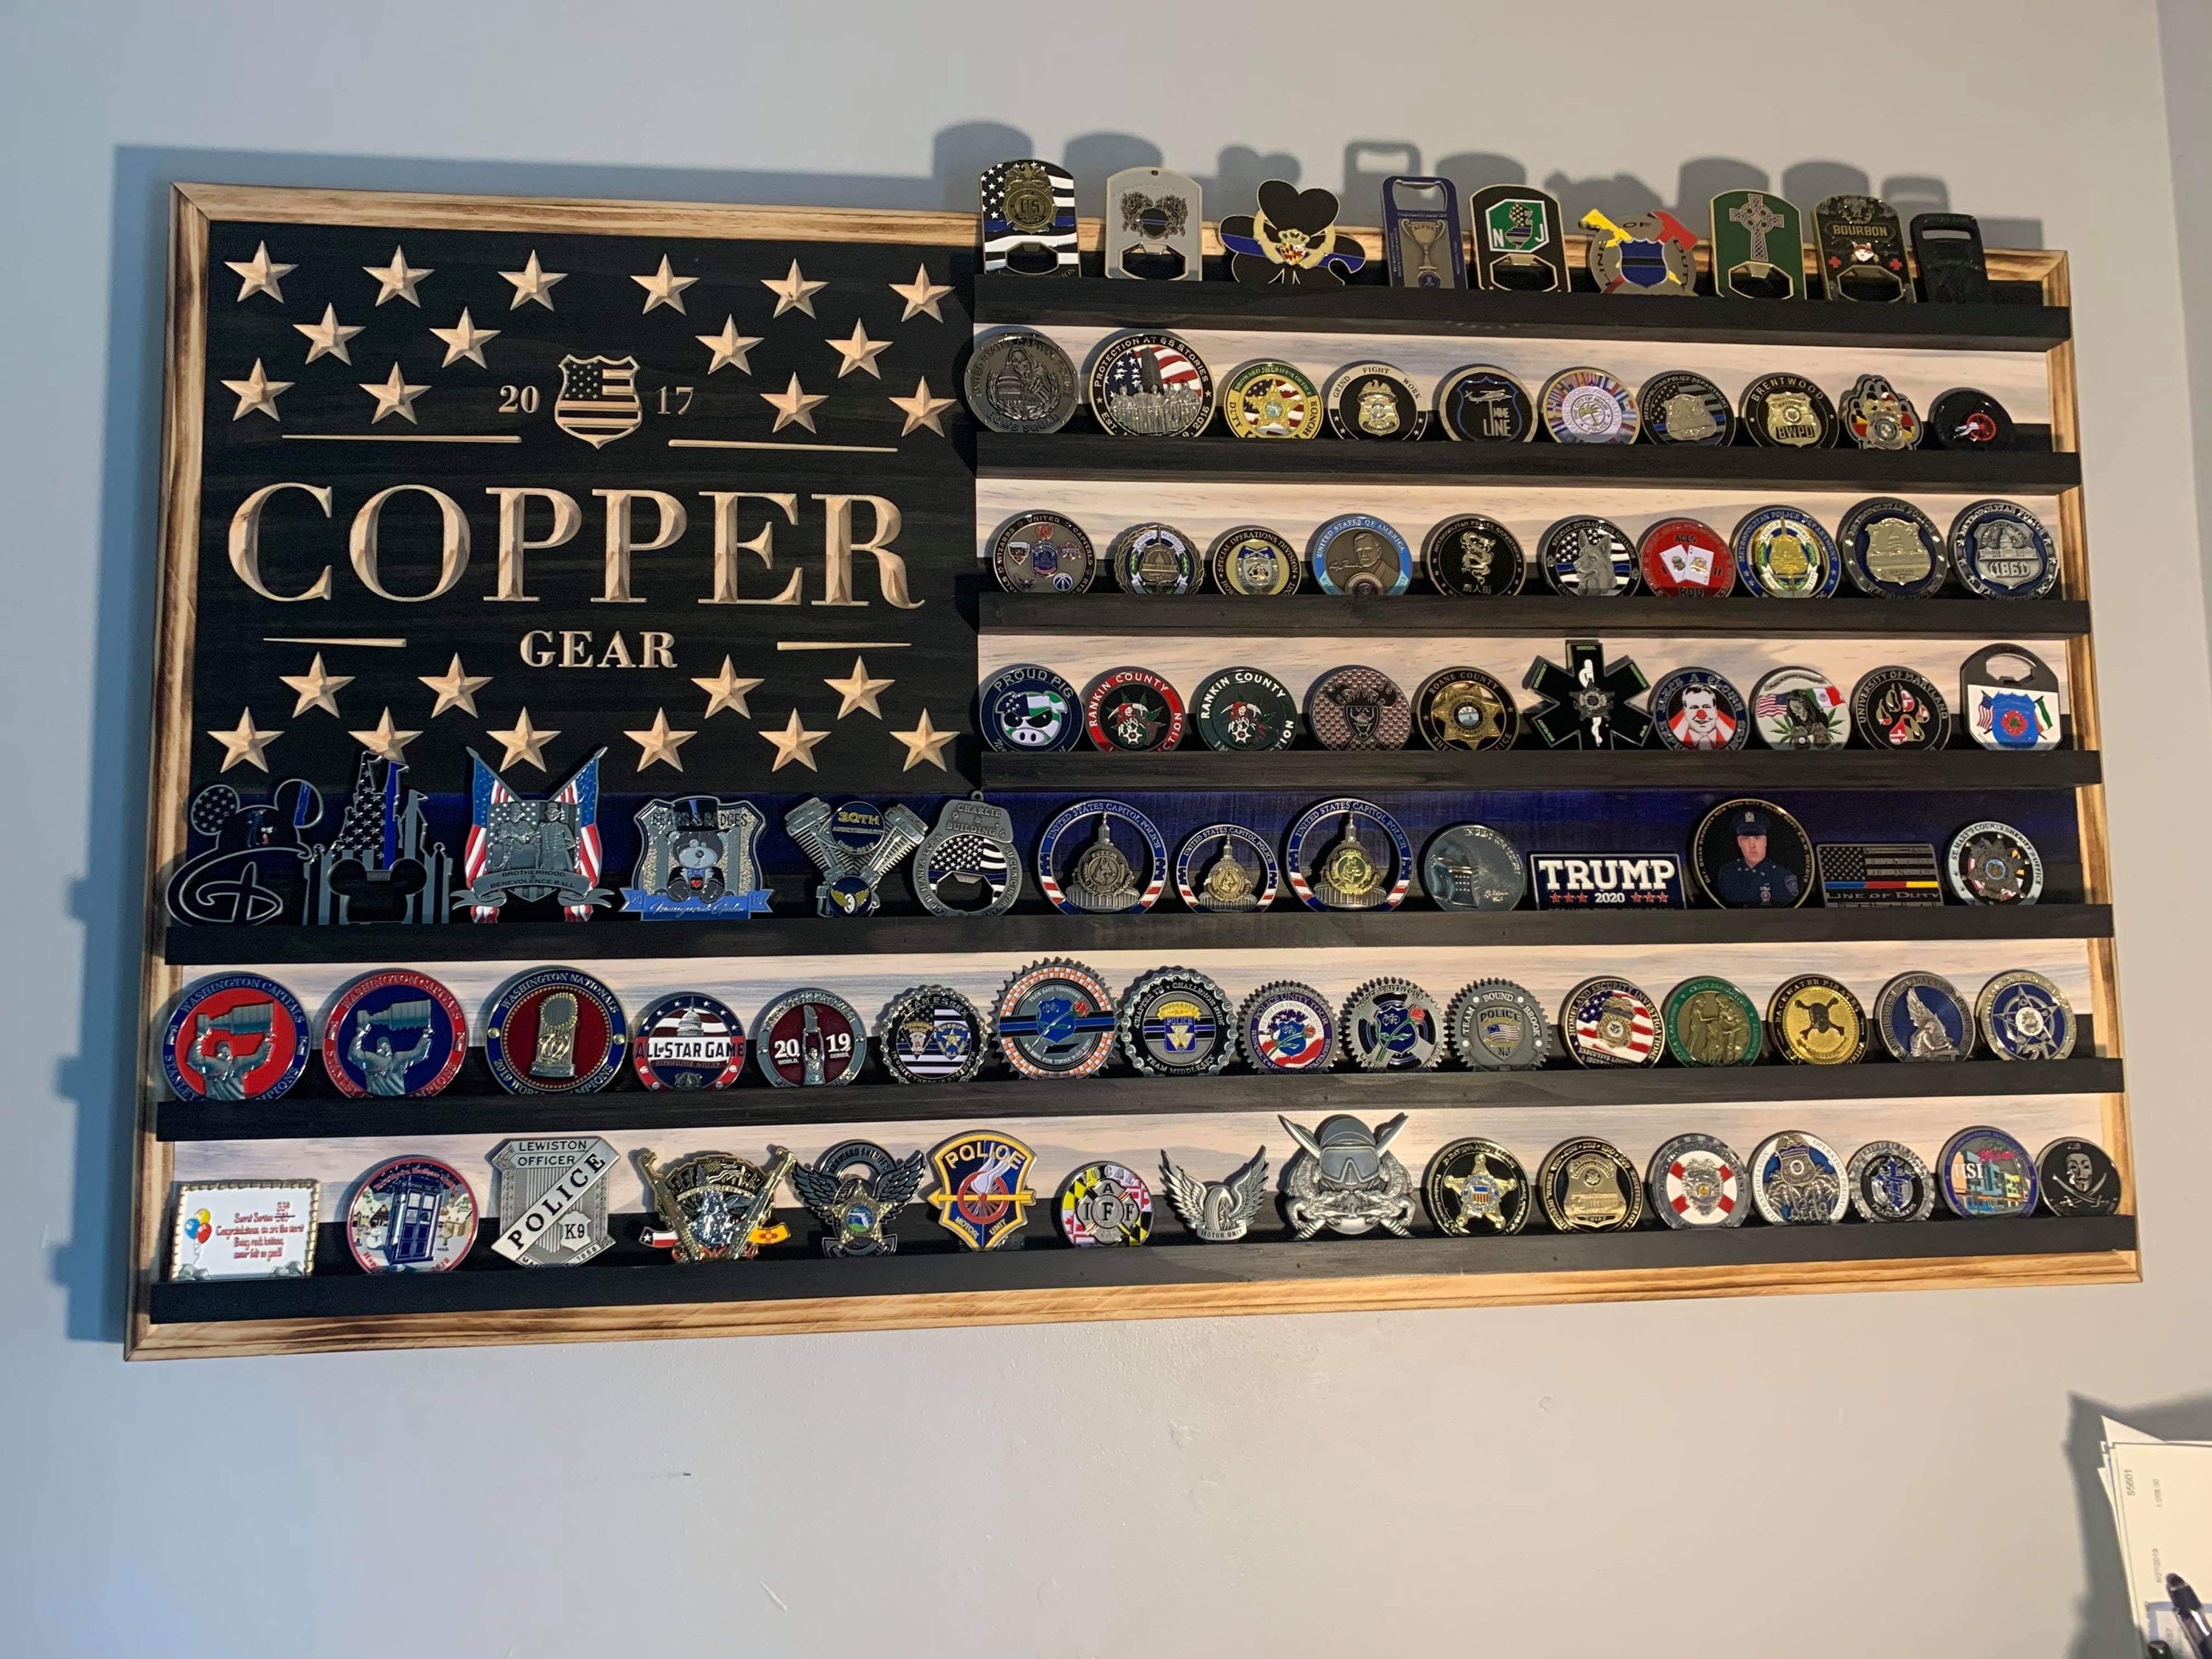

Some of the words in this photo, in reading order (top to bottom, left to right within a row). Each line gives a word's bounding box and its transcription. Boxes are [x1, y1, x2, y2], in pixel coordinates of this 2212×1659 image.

[1492, 226, 1505, 248] N
[1534, 223, 1545, 242] J
[1832, 224, 1888, 237] BOURBON
[1622, 220, 1652, 229] OF
[1673, 237, 1690, 288] DUTY
[1093, 337, 1141, 389] PROTECTION
[1143, 335, 1158, 344] AT
[1160, 335, 1177, 347] 65
[1176, 344, 1210, 383] STORIES
[1362, 366, 1391, 375] FIGHT
[498, 385, 540, 414] 20
[1332, 375, 1352, 399] GRIND
[1402, 377, 1423, 400] WORK
[1644, 379, 1668, 421] METROPOLITAN
[1691, 377, 1729, 410] DEPARTMENT
[1751, 377, 1824, 402] BRENTWOOD
[657, 386, 695, 415] 17
[1022, 414, 1060, 433] SQUAD
[1193, 406, 1210, 430] 2015
[1229, 400, 1244, 428] DUTY
[1302, 400, 1321, 437] HONOR
[1775, 426, 1815, 439] BWPD
[1316, 529, 1334, 557] UNITED
[1333, 518, 1363, 531] STATES
[1377, 524, 1406, 552] AMERICA
[1433, 521, 1470, 553] METROPOLITAN
[1470, 521, 1496, 529] POLICE
[1495, 528, 1523, 563] DEPARTMENT
[1552, 526, 1573, 546] SPECIAL
[1614, 532, 1637, 559] DIVISION
[1739, 512, 1771, 563] METROPOLITAN
[1770, 510, 1801, 520] POLICE
[1801, 518, 1838, 562] DEPARTMENT
[1762, 521, 1781, 538] POLICE
[1787, 522, 1812, 542] ACADEMY
[228, 481, 925, 610] COPPER
[997, 527, 1015, 565] WIZARDS
[1072, 528, 1094, 566] CAPITALS
[1217, 543, 1231, 574] SPECIAL
[1231, 531, 1278, 546] OPERATIONS
[1277, 540, 1298, 574] DIVISION
[519, 630, 678, 669] GEAR
[997, 669, 1048, 692] PROUD
[1050, 676, 1074, 699] PIG
[1428, 672, 1458, 695] ROANE
[1460, 671, 1500, 691] COUNTY
[1088, 681, 1112, 728] RANKIN
[1115, 672, 1169, 692] COUNTY
[1200, 677, 1231, 720] RANKIN
[1234, 672, 1287, 699] COUNTY
[1857, 673, 1889, 724] UNIVERSITY
[1905, 673, 1948, 720] MARYLAND
[652, 812, 689, 827] BEARS
[692, 812, 701, 824] &
[704, 812, 748, 827] BADGES
[956, 803, 1002, 818] CHARLIE
[946, 821, 996, 837] BUILDING
[1046, 813, 1074, 841] UNITED
[1072, 801, 1105, 819] STATES
[1105, 801, 1141, 825] CAPITOL
[1140, 820, 1162, 850] POLICE
[1295, 812, 1321, 838] UNITED
[1318, 801, 1351, 818] STATES
[1352, 801, 1387, 824] CAPITOL
[1385, 819, 1408, 849] POLICE
[1183, 836, 1204, 857] UNITED
[1203, 827, 1228, 841] STATES
[1228, 827, 1257, 844] CAPITOL
[1256, 841, 1274, 865] POLICE
[1954, 827, 1976, 850] MARY'S
[1975, 824, 2005, 832] COUNTY
[2032, 856, 2042, 886] OFFICE
[490, 877, 554, 889] BENEVOLENCE
[553, 878, 574, 888] BALL
[501, 869, 566, 877] BROTHERHOOD
[917, 859, 927, 883] AREA
[1009, 858, 1018, 886] CLINIC
[1538, 859, 1676, 891] TRUMP
[1594, 892, 1626, 904] 2020
[1869, 891, 1888, 900] OF
[1895, 890, 1941, 899] DUTY
[183, 977, 264, 1014] WASHINGTON
[262, 979, 305, 1024] CAPITALS
[341, 973, 417, 1008] WASHINGTON
[501, 973, 570, 1010] WASHINGTON
[570, 973, 620, 1015] NATIONALS
[1041, 986, 1054, 994] EAST
[1357, 987, 1380, 1010] POLICE
[1482, 992, 1514, 1003] BOUND
[901, 996, 930, 1017] TEAM
[932, 996, 969, 1017] ESSEX
[1133, 992, 1155, 1029] CHAPTER
[1255, 995, 1282, 1022] POLICE
[1280, 992, 1310, 1004] UNITY
[1310, 999, 1329, 1026] TOUR
[1284, 1003, 1303, 1012] THOSE
[1480, 1009, 1522, 1023] POLICE
[1166, 1017, 1193, 1026] POLICE
[1462, 1006, 1476, 1034] TEAM
[1524, 1005, 1542, 1038] BROOK
[1569, 987, 1593, 1036] HOMELAND
[1590, 981, 1632, 993] SECURITY
[1632, 989, 1663, 1062] INVESTIGATIONS
[705, 1042, 745, 1059] GAME
[773, 1038, 800, 1060] 20
[825, 1032, 852, 1054] 19
[1498, 1047, 1512, 1057] NJ
[492, 1057, 511, 1082] 2019
[1146, 1054, 1168, 1073] TEAM
[1169, 1054, 1216, 1075] MIDDLESEX
[519, 1139, 588, 1152] LEWISTON
[943, 1143, 1025, 1169] POLICE
[1812, 1138, 1844, 1175] OPERATION
[518, 1155, 576, 1166] OFFICER
[827, 1147, 860, 1173] BROWARD
[1955, 1162, 1985, 1180] HSI
[507, 1151, 606, 1251] POLICE
[1104, 1183, 1113, 1194] A
[1102, 1202, 1114, 1221] F
[1124, 1203, 1134, 1220] F
[954, 1215, 979, 1241] MOTOR
[989, 1218, 1006, 1236] UNIT
[1200, 1229, 1225, 1239] MOTOR
[1226, 1229, 1242, 1239] UNIT
